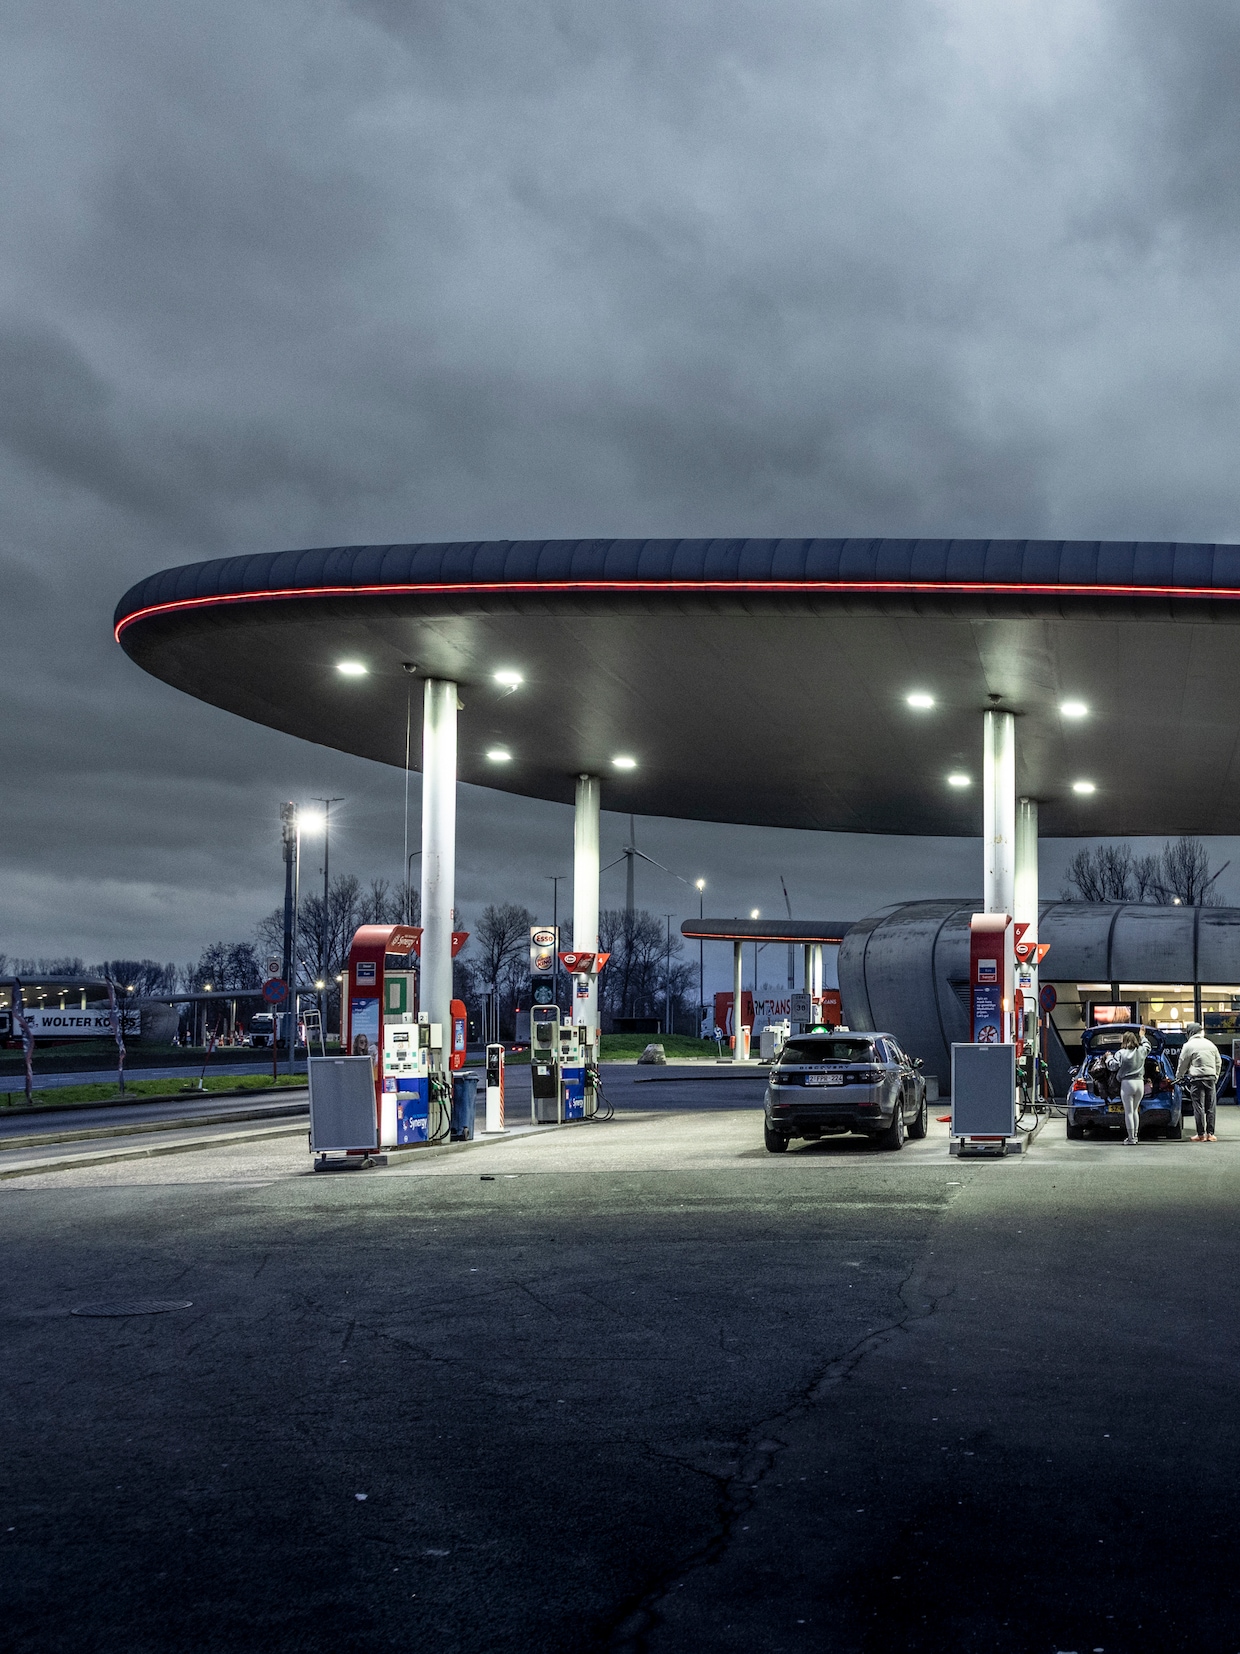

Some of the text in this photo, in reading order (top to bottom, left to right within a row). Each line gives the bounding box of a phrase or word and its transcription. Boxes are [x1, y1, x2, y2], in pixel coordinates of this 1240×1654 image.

[536, 935, 553, 943] Esso
[537, 960, 552, 968] KING
[796, 1004, 806, 1012] 30
[42, 1017, 136, 1027] WOLTER KOPS
[410, 1117, 428, 1130] Synergy
